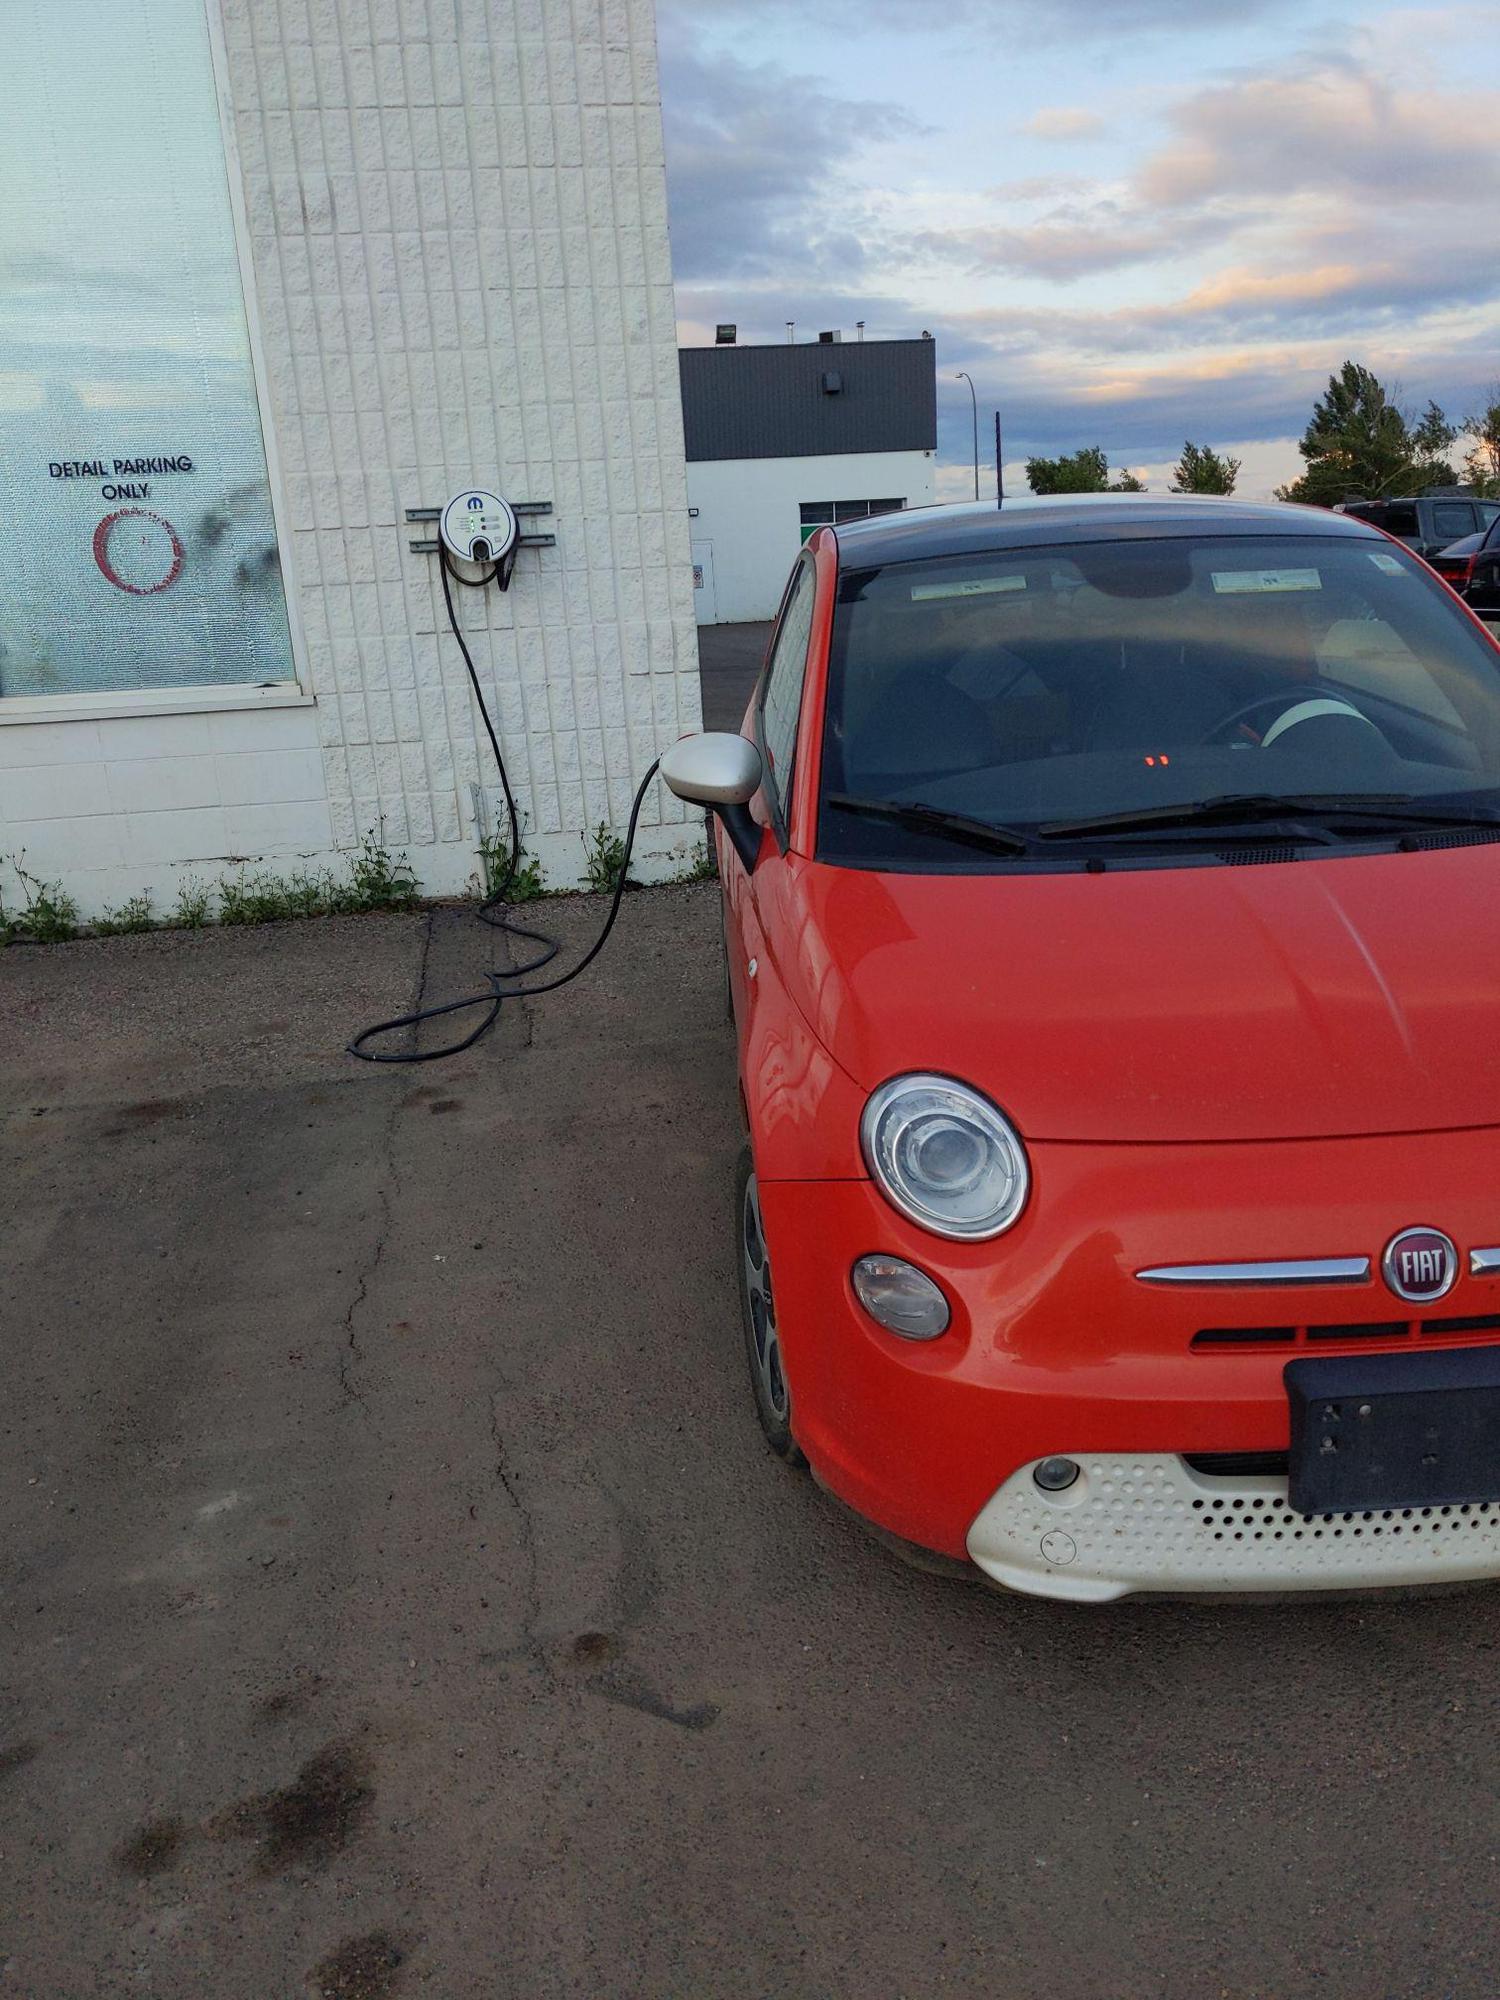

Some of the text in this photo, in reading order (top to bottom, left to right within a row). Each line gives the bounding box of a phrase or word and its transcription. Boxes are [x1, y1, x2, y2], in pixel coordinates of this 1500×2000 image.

[49, 455, 193, 478] DETAIL PARKING
[101, 483, 149, 500] ONLY
[1401, 1248, 1443, 1283] FIAT
